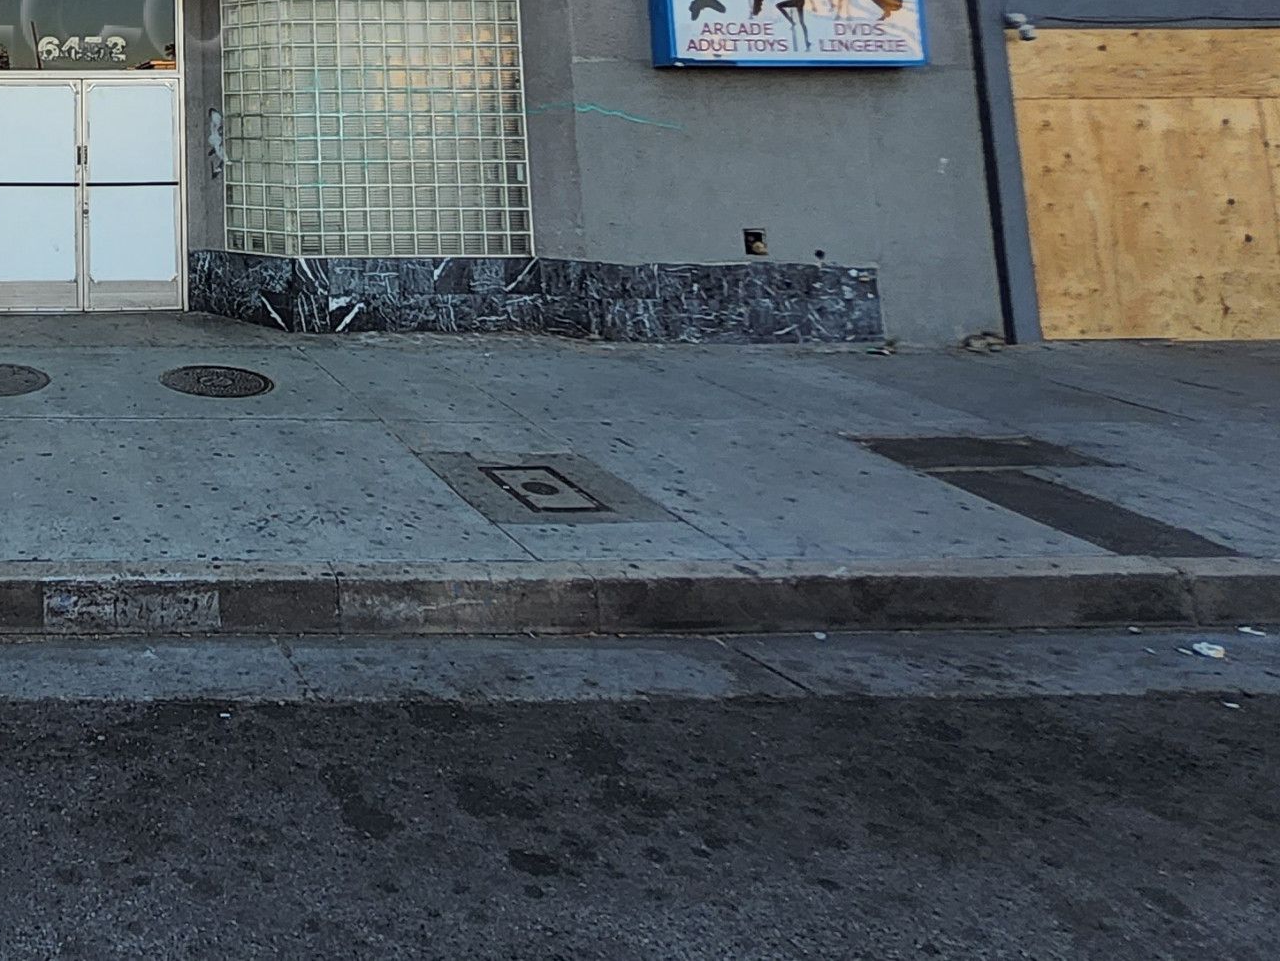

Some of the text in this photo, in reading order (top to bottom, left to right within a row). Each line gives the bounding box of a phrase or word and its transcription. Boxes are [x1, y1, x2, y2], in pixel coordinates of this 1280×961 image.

[700, 22, 774, 36] ARCADE
[833, 23, 886, 37] DVDS
[686, 39, 789, 53] ADULT TOYS
[819, 39, 907, 53] LINGERIE
